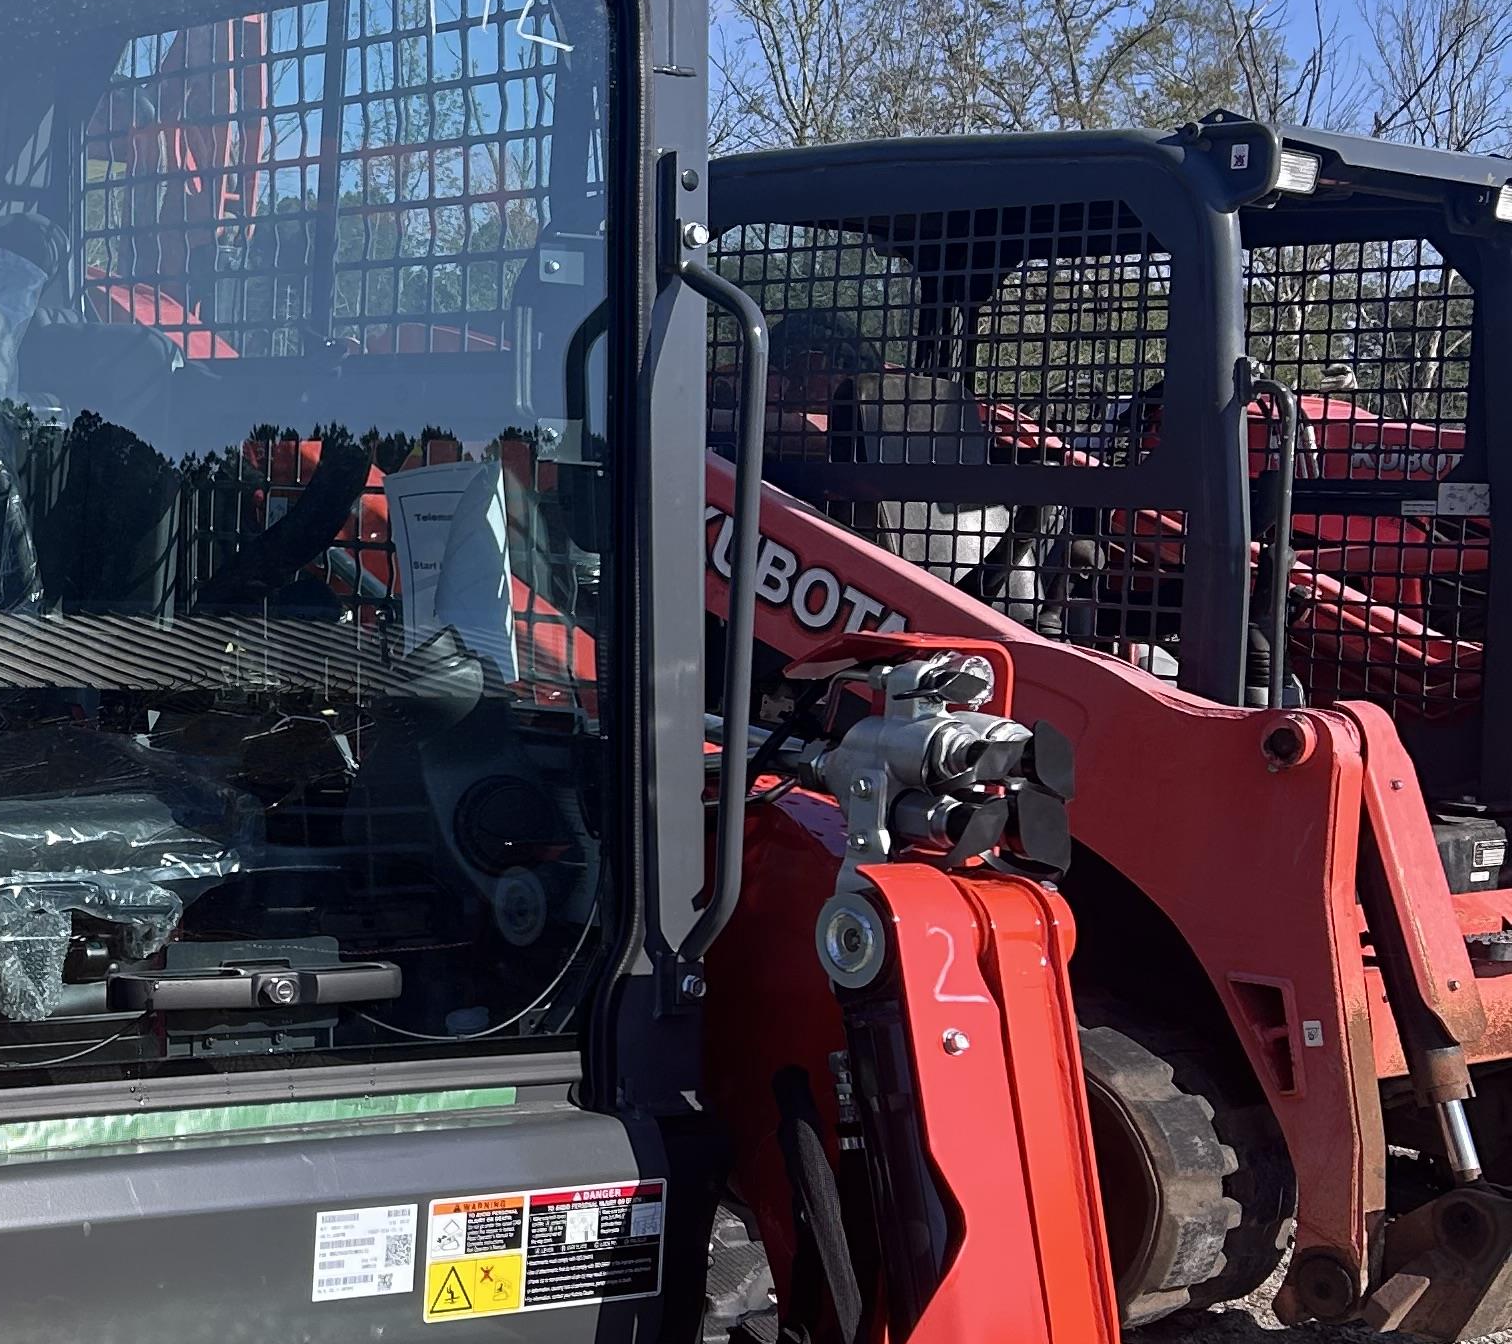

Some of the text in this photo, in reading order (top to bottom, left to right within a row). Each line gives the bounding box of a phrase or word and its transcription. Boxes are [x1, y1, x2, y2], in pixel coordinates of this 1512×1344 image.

[1350, 442, 1465, 476] KUBOT
[926, 922, 990, 1004] 2
[463, 1200, 506, 1211] WARNING
[583, 1189, 622, 1200] DANGER
